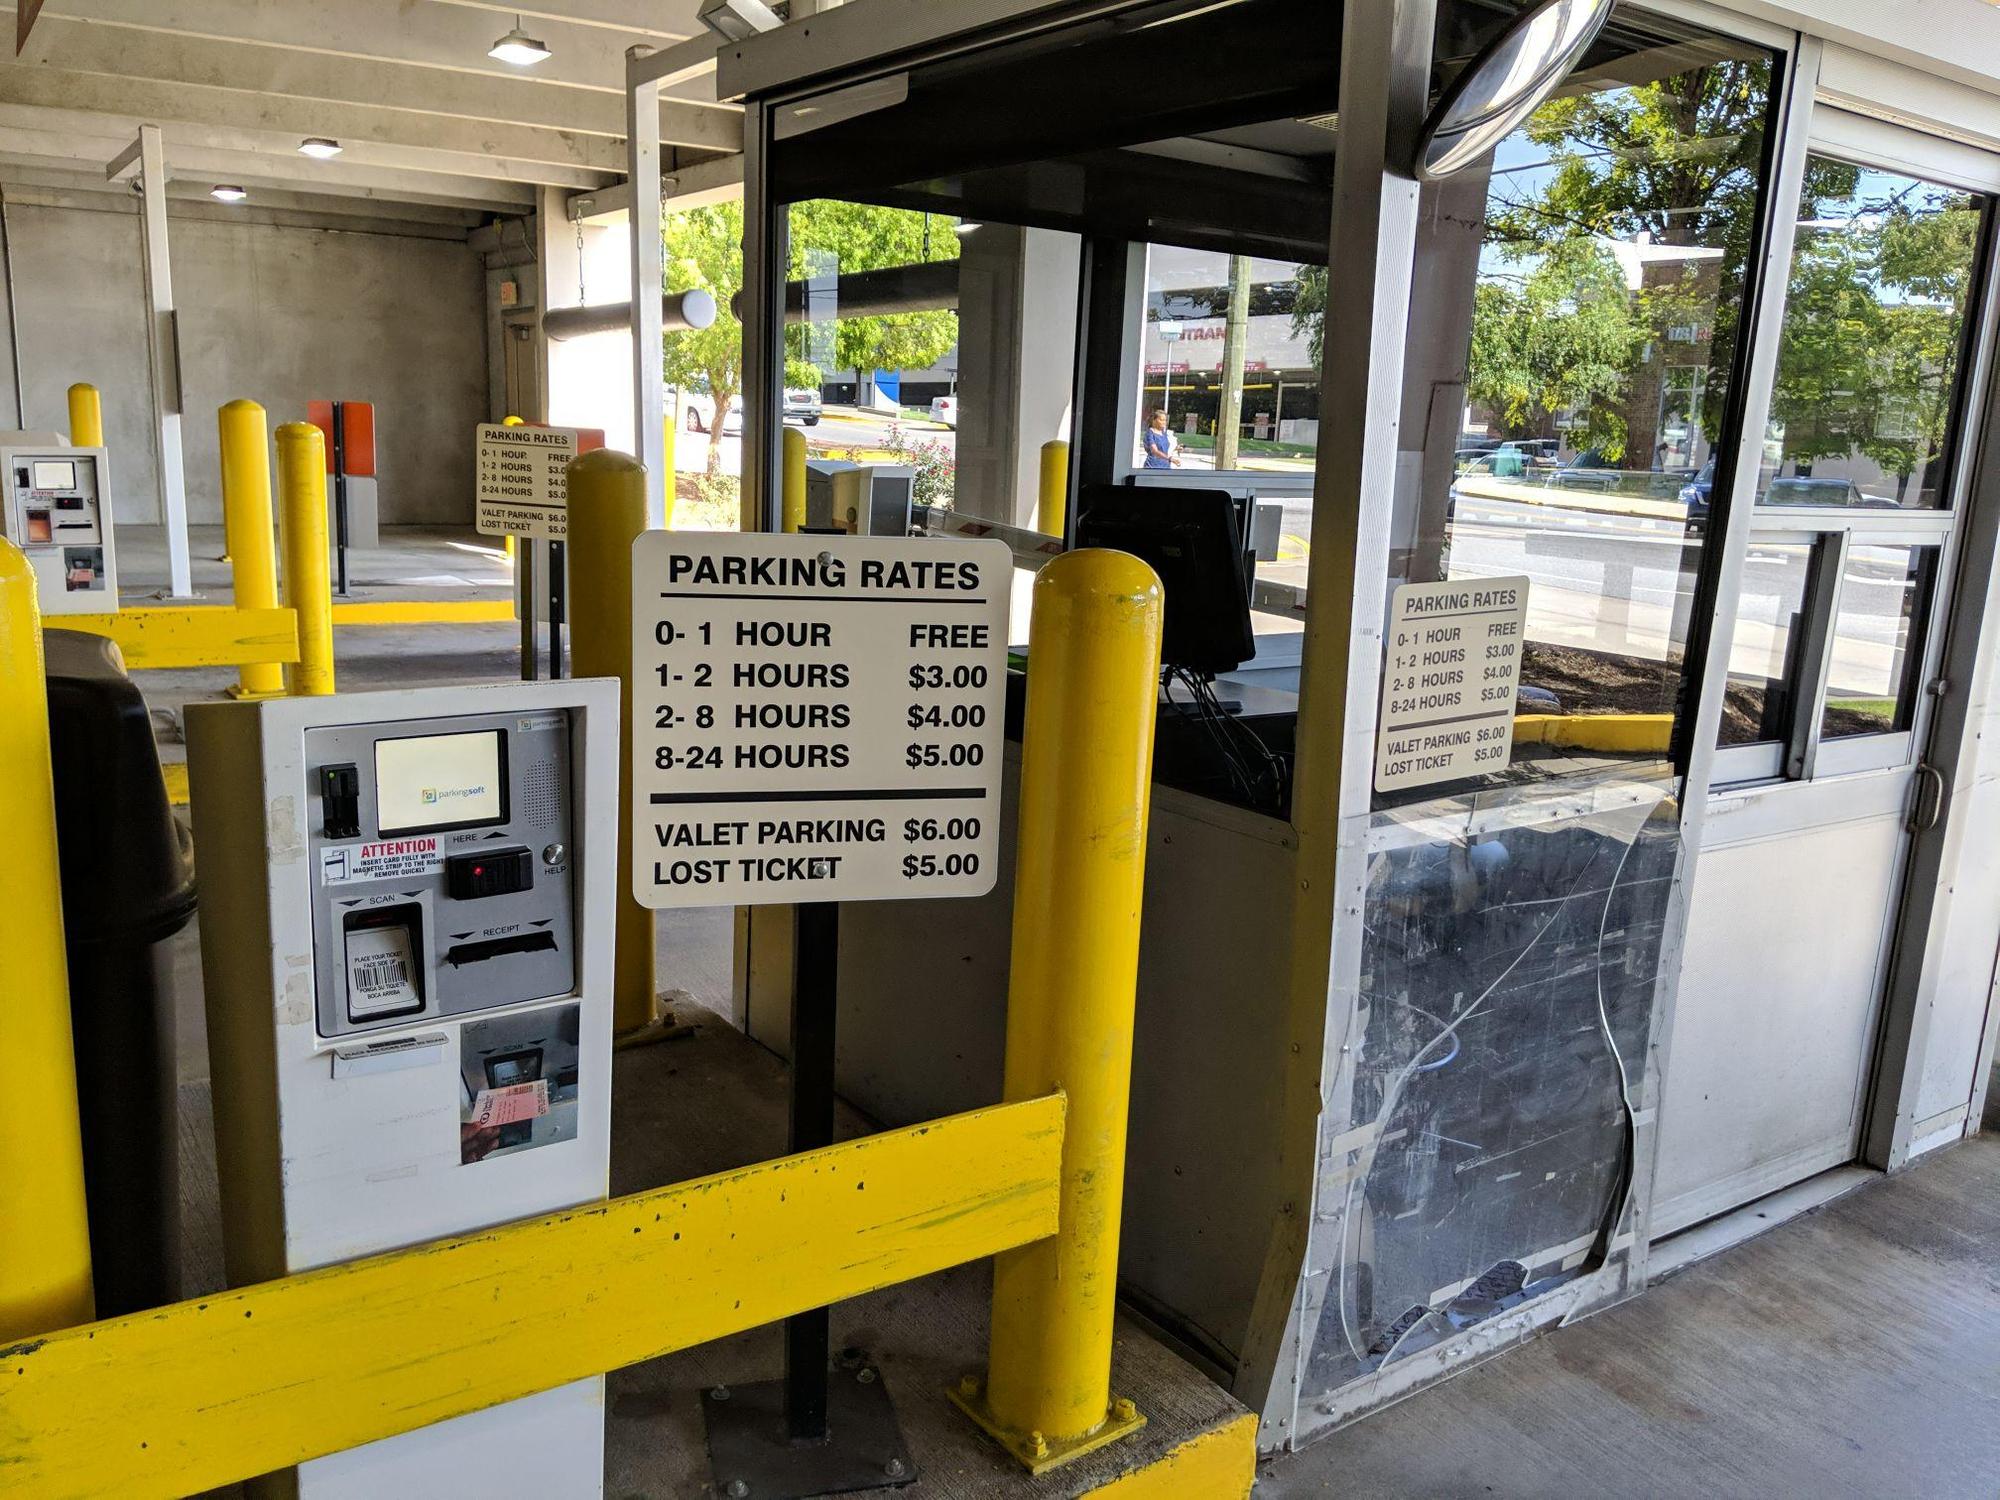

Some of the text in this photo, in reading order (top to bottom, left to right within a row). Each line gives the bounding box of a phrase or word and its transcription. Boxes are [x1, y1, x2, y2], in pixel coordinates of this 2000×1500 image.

[485, 431, 568, 444] PARKING RATES
[548, 454, 571, 462] FREE
[501, 463, 532, 472] HOURS
[548, 466, 566, 475] $3.0
[501, 475, 532, 484] HOURS
[548, 478, 566, 487] $4.0
[482, 486, 566, 499] 8-24 HOURS $5.0
[482, 508, 566, 522] VALET PARKING $6.0
[503, 522, 531, 530] TICKET
[548, 526, 566, 534] $5.0
[669, 555, 980, 590] PARKING RATES
[1406, 590, 1517, 613] PARKING RATES
[735, 621, 831, 647] HOUR
[909, 624, 989, 648] FREE
[1426, 628, 1461, 644] HOUR
[1488, 622, 1517, 637] FREE
[1423, 649, 1465, 666] HOURS
[1486, 644, 1514, 659] $3.00
[733, 663, 850, 688] HOURS
[908, 665, 987, 690] $3.00
[1421, 671, 1464, 688] HOURS
[1484, 665, 1512, 681] $4.00
[1391, 686, 1509, 713] 8-24 HOURS $5.00
[735, 704, 850, 728] HOURS
[907, 704, 985, 729] $4.00
[1388, 726, 1505, 755] VALET PARKING $6.00
[655, 744, 984, 769] 8-24 HOURS $5.00
[1385, 746, 1503, 776] LOST TICKET $5.00
[438, 786, 485, 800] parkingsoft
[453, 833, 477, 843] HERE
[654, 818, 981, 847] VALET PARKING $6.00
[361, 838, 436, 858] ATTENTION
[353, 866, 383, 874] MAGNETIC
[374, 870, 399, 878] REMOVE
[544, 866, 566, 875] HELP
[654, 854, 979, 885] LOST TICKET $5.00
[370, 894, 395, 905] SCAN
[483, 924, 520, 937] RECEIPT
